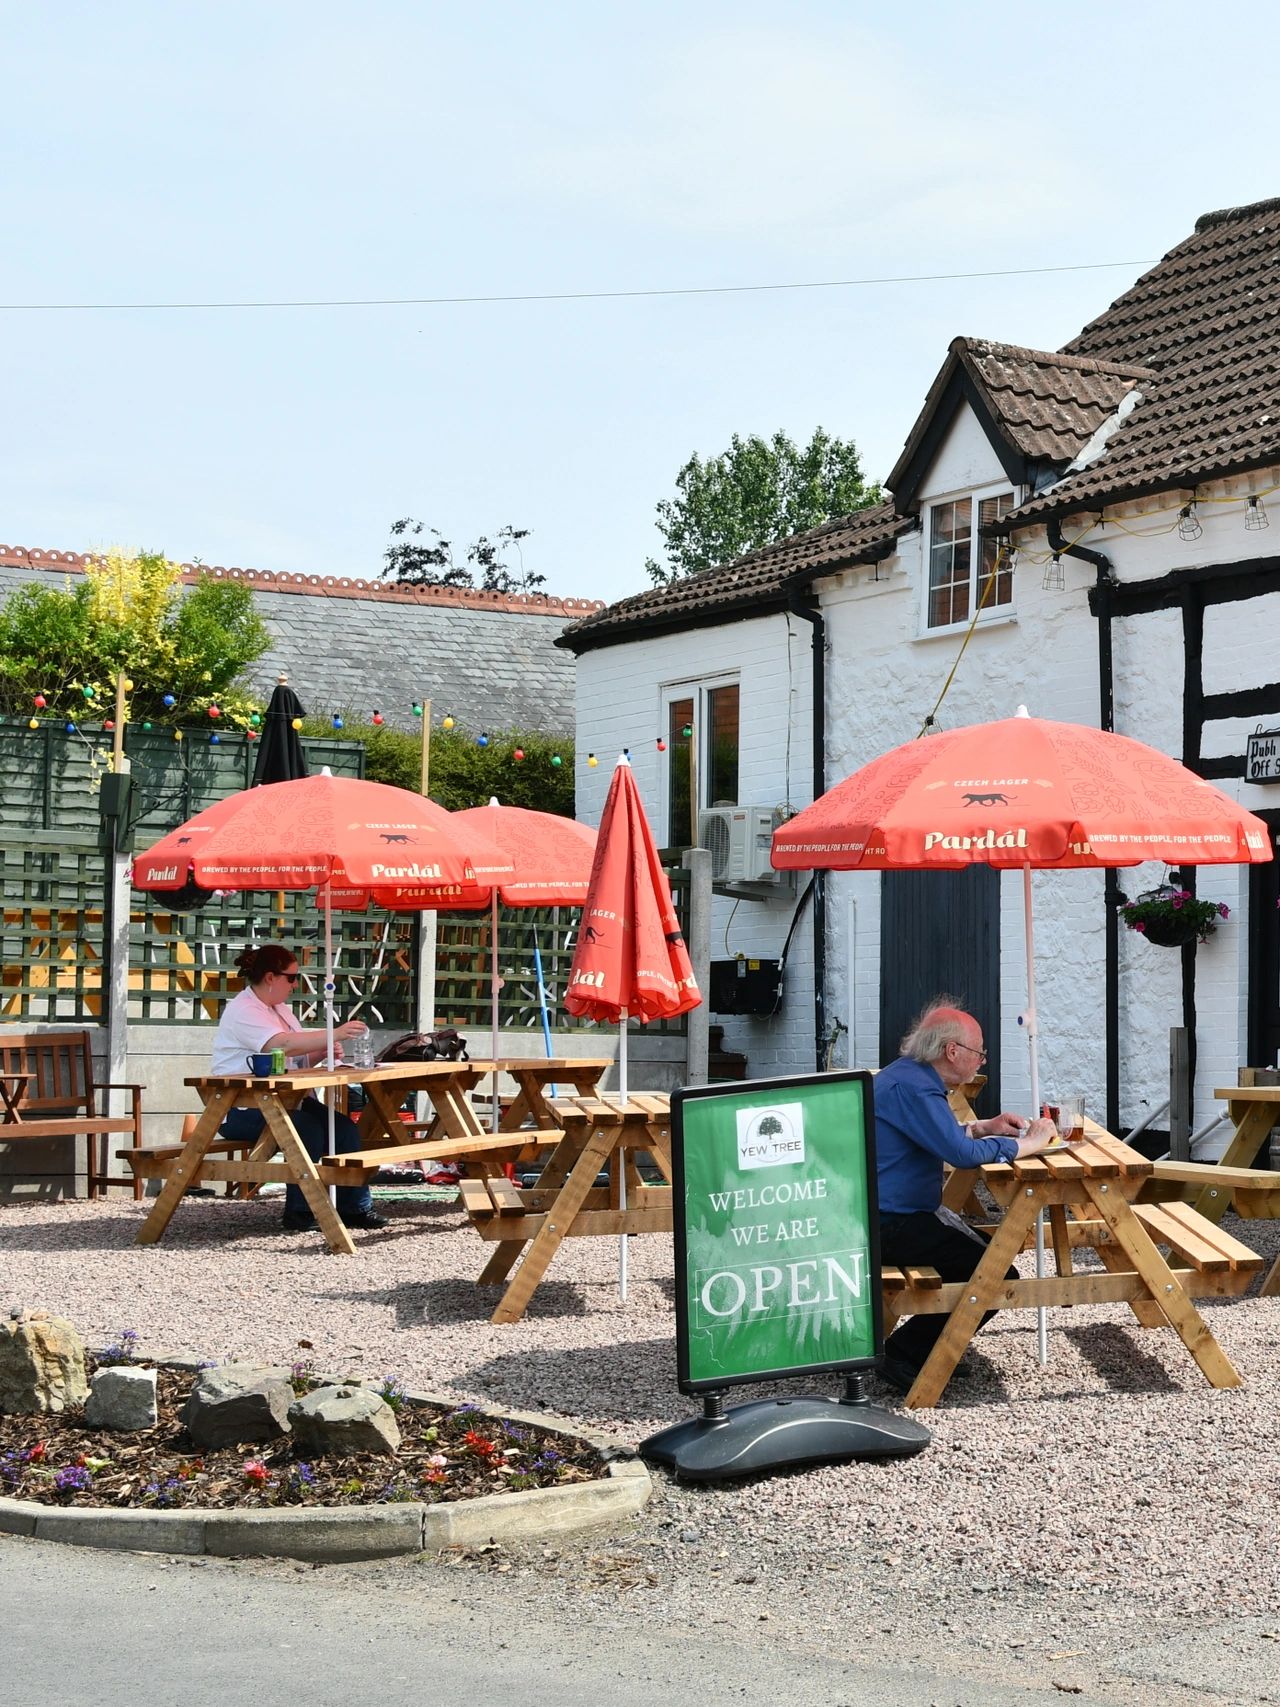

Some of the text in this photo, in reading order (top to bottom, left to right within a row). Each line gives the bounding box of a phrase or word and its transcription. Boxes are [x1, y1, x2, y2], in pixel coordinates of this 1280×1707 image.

[1251, 759, 1271, 777] Off
[925, 828, 1029, 850] Pardál
[1089, 834, 1117, 842] BREWED
[1130, 835, 1142, 843] THE
[1204, 835, 1231, 843] PEOPLE
[147, 866, 177, 881] Pardál
[371, 864, 442, 878] Pardál
[573, 969, 605, 988] dál
[740, 1141, 801, 1157] YEW TREE
[709, 1179, 827, 1212] WELCOME
[732, 1218, 819, 1246] WE ARE
[701, 1254, 864, 1317] OPEN
